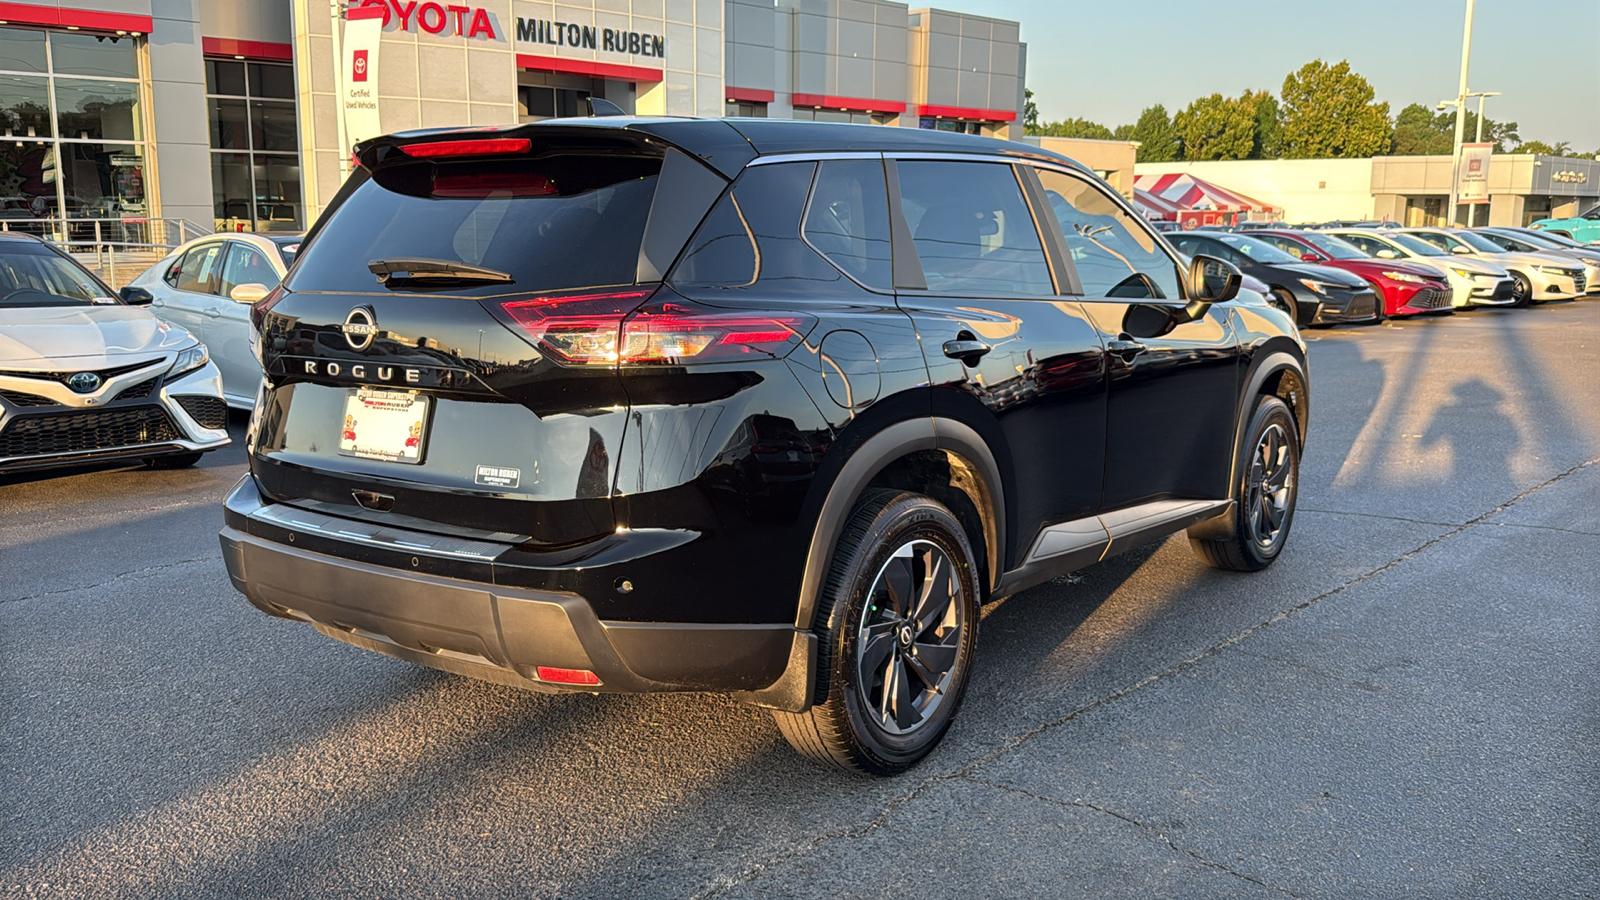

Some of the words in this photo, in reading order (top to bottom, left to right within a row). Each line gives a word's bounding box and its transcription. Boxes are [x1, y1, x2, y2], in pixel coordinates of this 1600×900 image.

[515, 17, 596, 50] MILTON
[602, 27, 664, 58] RUBEN
[350, 89, 370, 97] Certified
[346, 101, 357, 109] Used
[357, 101, 376, 109] Vehicles
[343, 324, 375, 334] NISSAN
[304, 360, 420, 383] ROGUE
